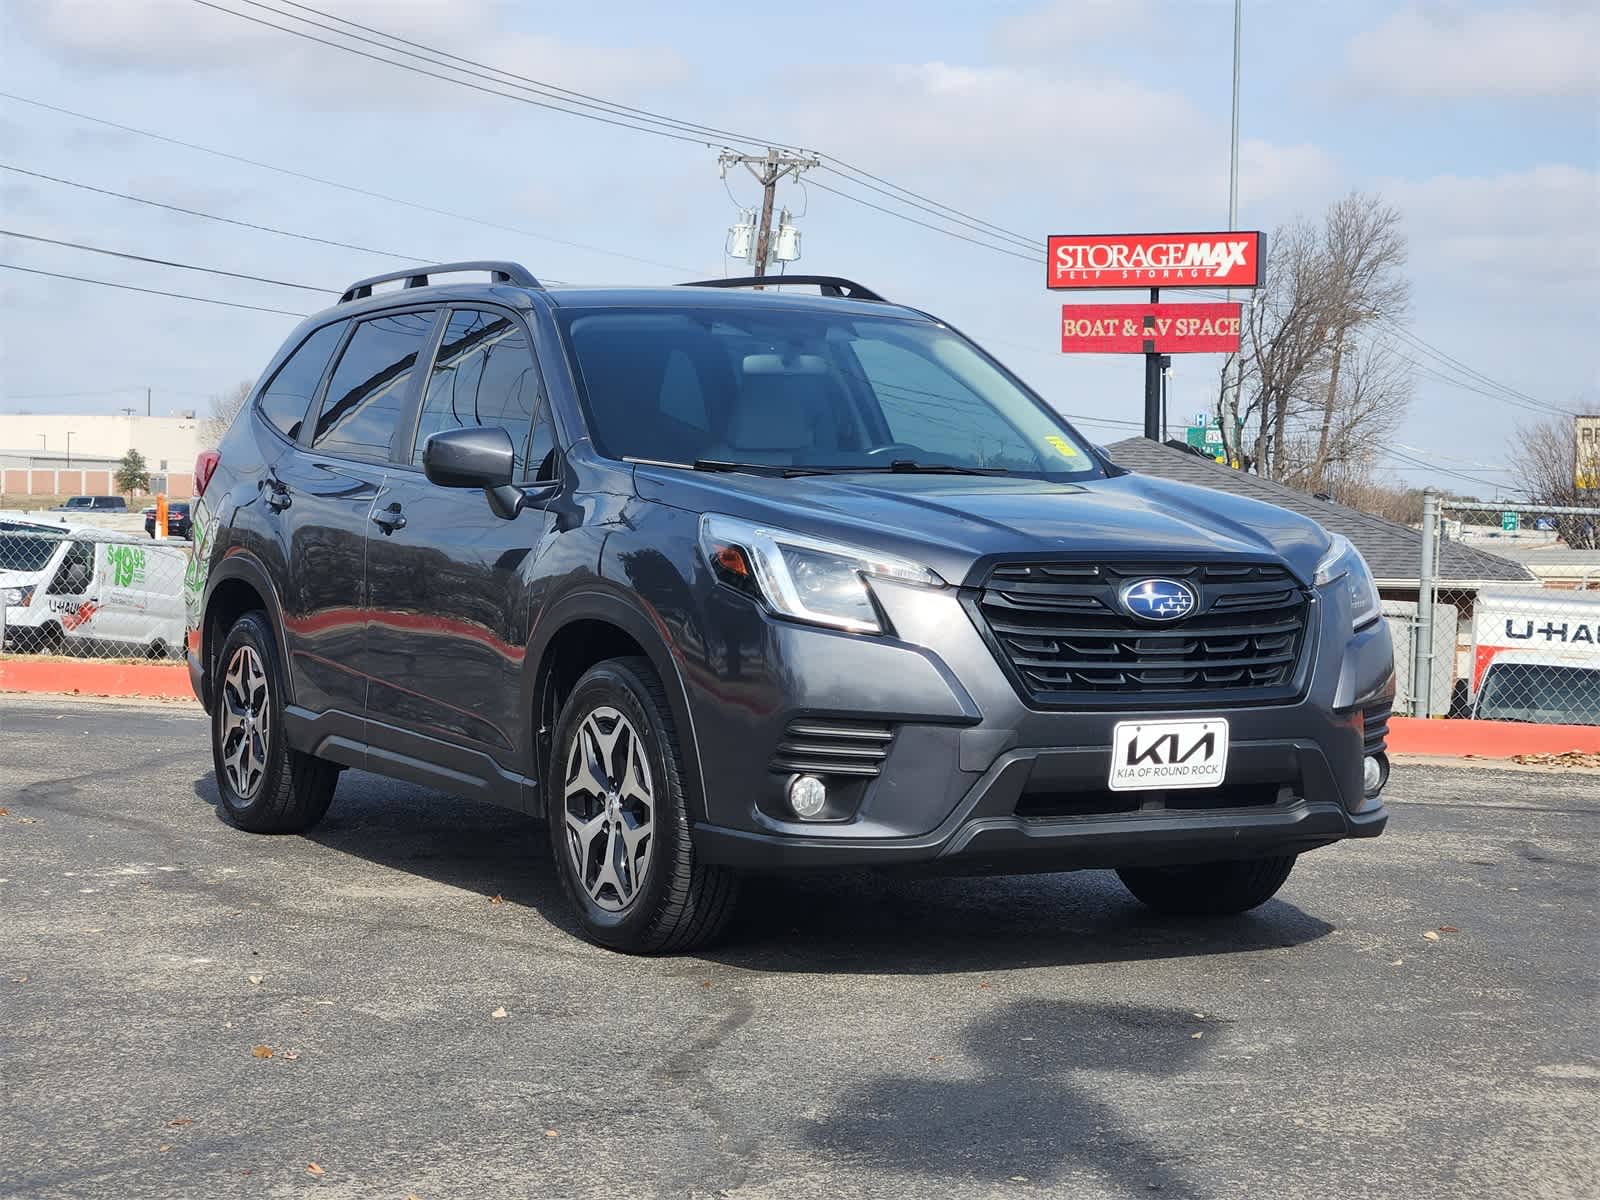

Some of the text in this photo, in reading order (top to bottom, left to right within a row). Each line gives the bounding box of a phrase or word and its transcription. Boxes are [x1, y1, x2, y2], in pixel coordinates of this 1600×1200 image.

[1056, 268, 1211, 279] SELF STORAGE
[1063, 319, 1119, 337] BOAT
[1122, 319, 1138, 336] &
[1175, 318, 1241, 335] SPACE
[1505, 619, 1600, 644] U-HA
[1127, 732, 1215, 766] KIA
[1117, 764, 1219, 778] KIA OF ROUND ROCK
